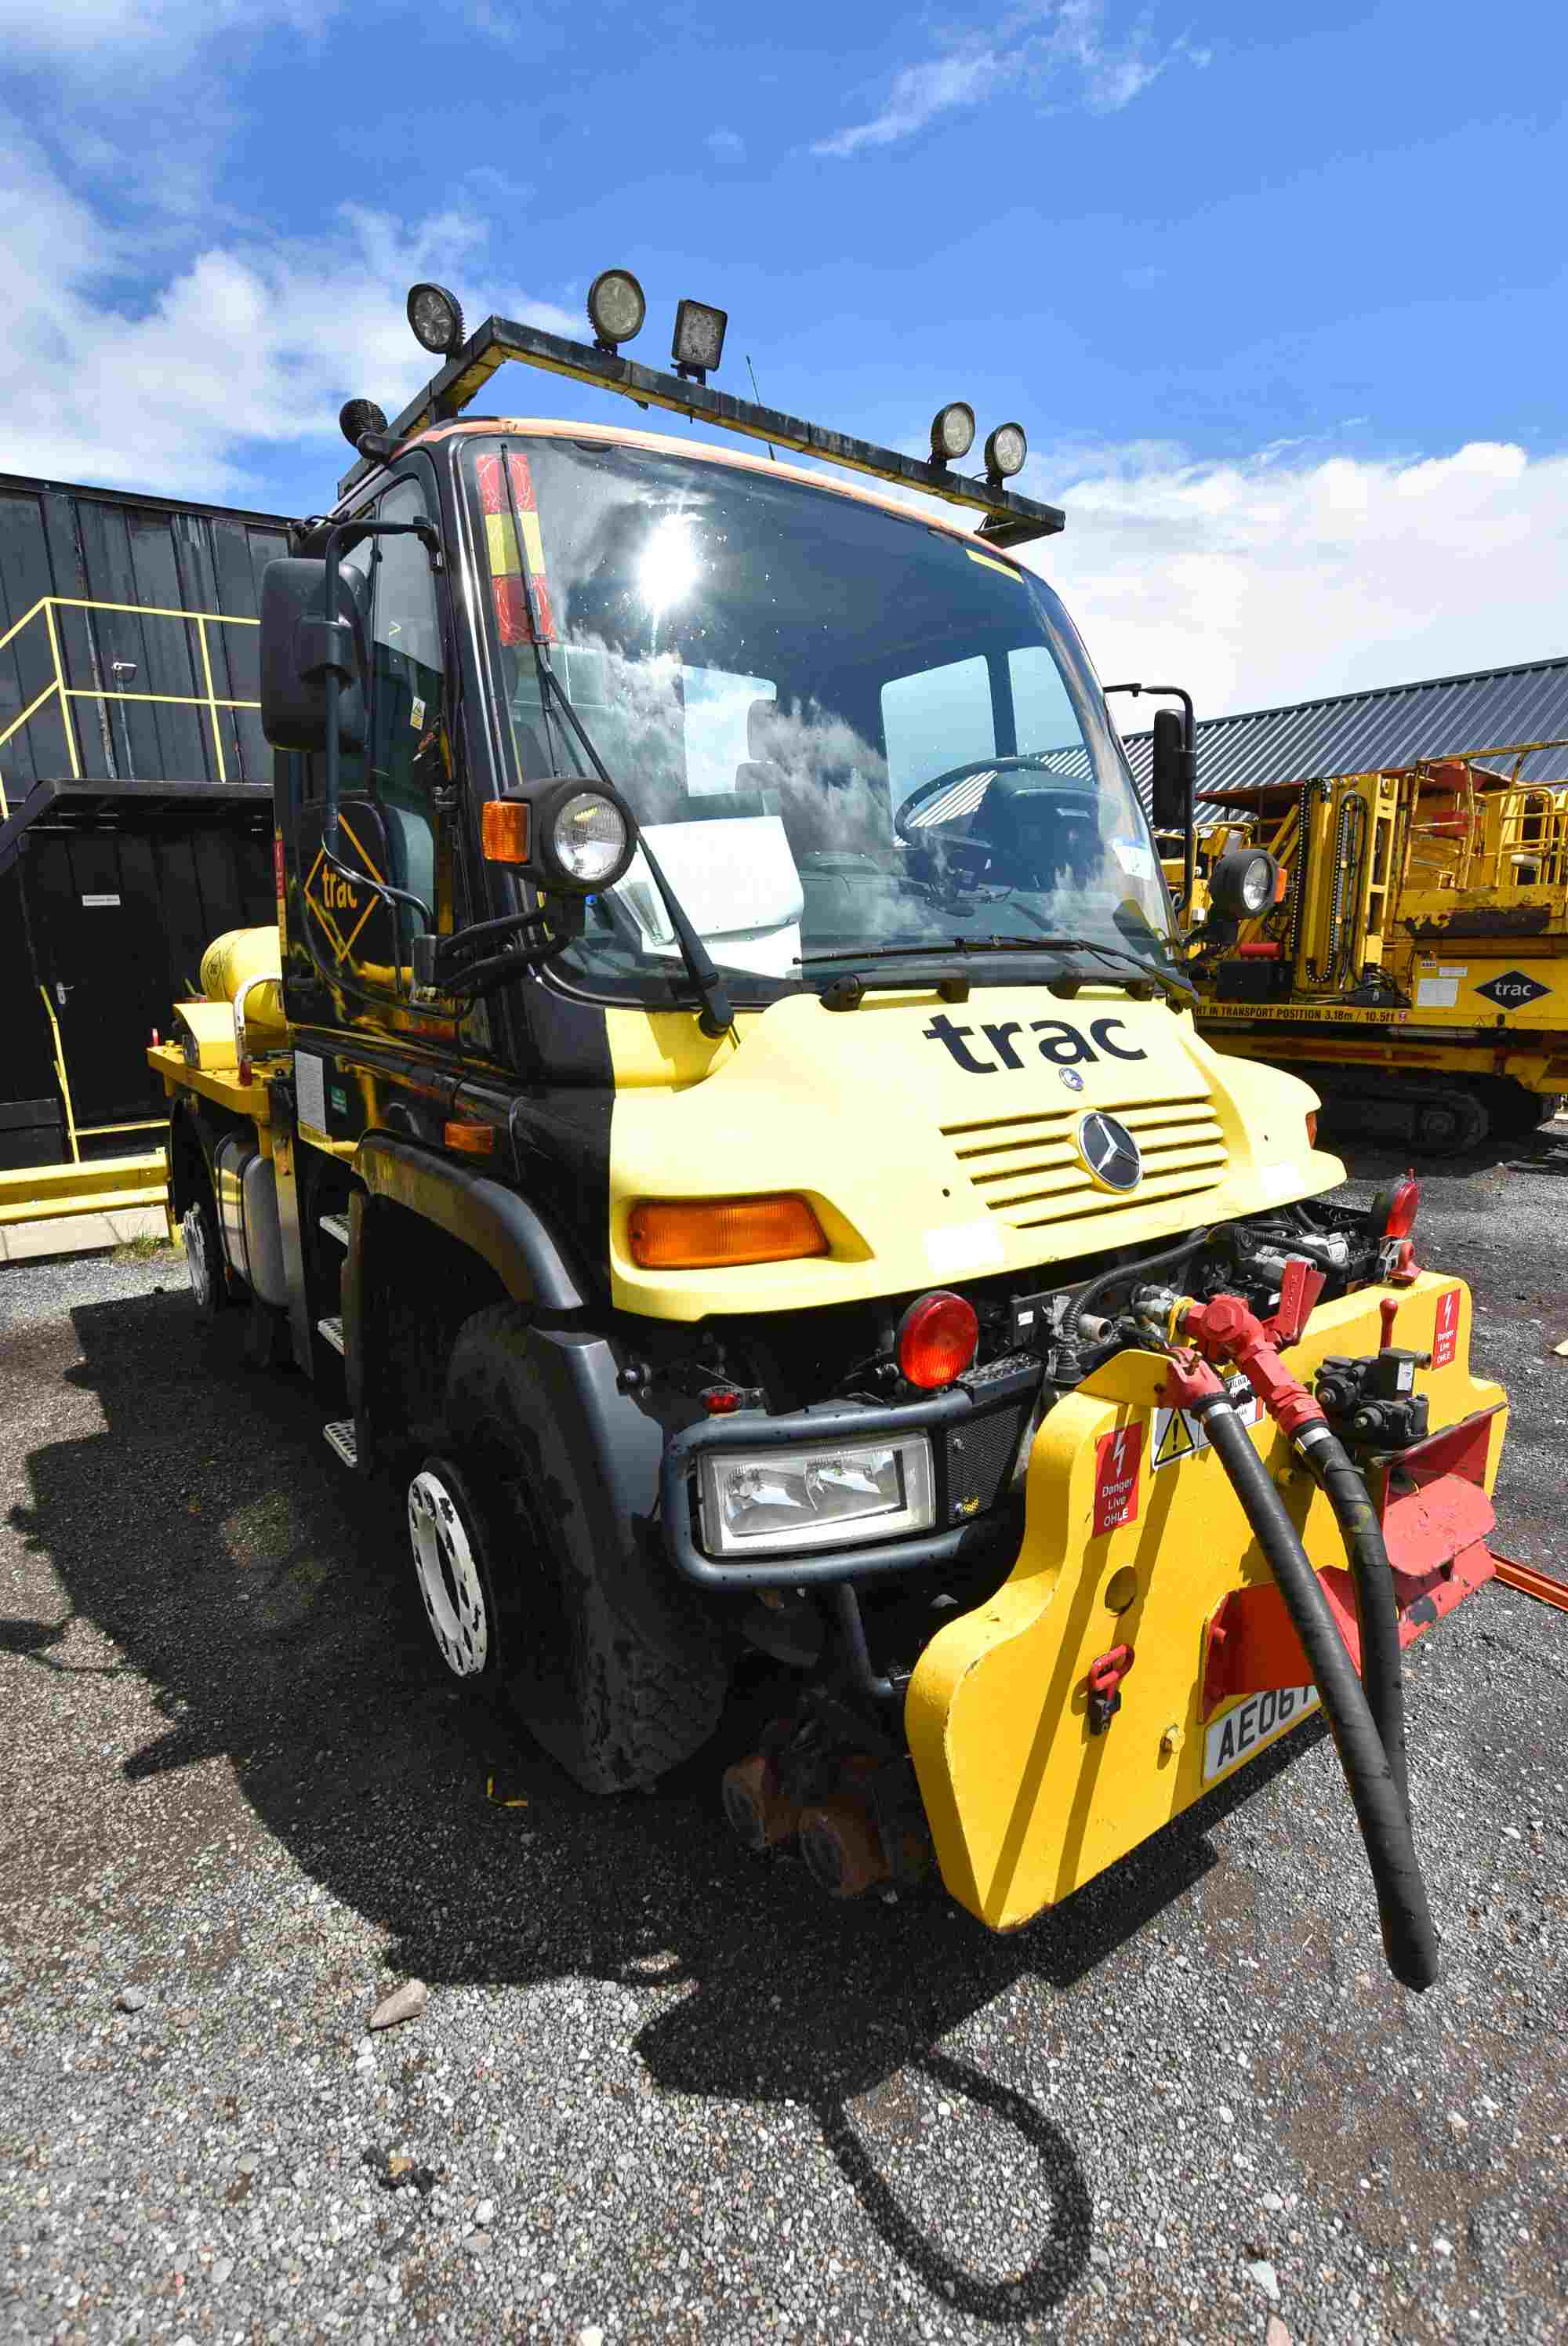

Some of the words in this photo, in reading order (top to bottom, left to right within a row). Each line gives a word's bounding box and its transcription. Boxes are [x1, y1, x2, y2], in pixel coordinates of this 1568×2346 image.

[322, 864, 358, 909] trac
[1494, 982, 1532, 996] trac
[1221, 1006, 1274, 1018] TRANSPORT
[1276, 1008, 1322, 1019] POSITION
[921, 1014, 1148, 1073] trac
[1102, 1478, 1133, 1497] Danger
[1104, 1506, 1129, 1527] OHLE
